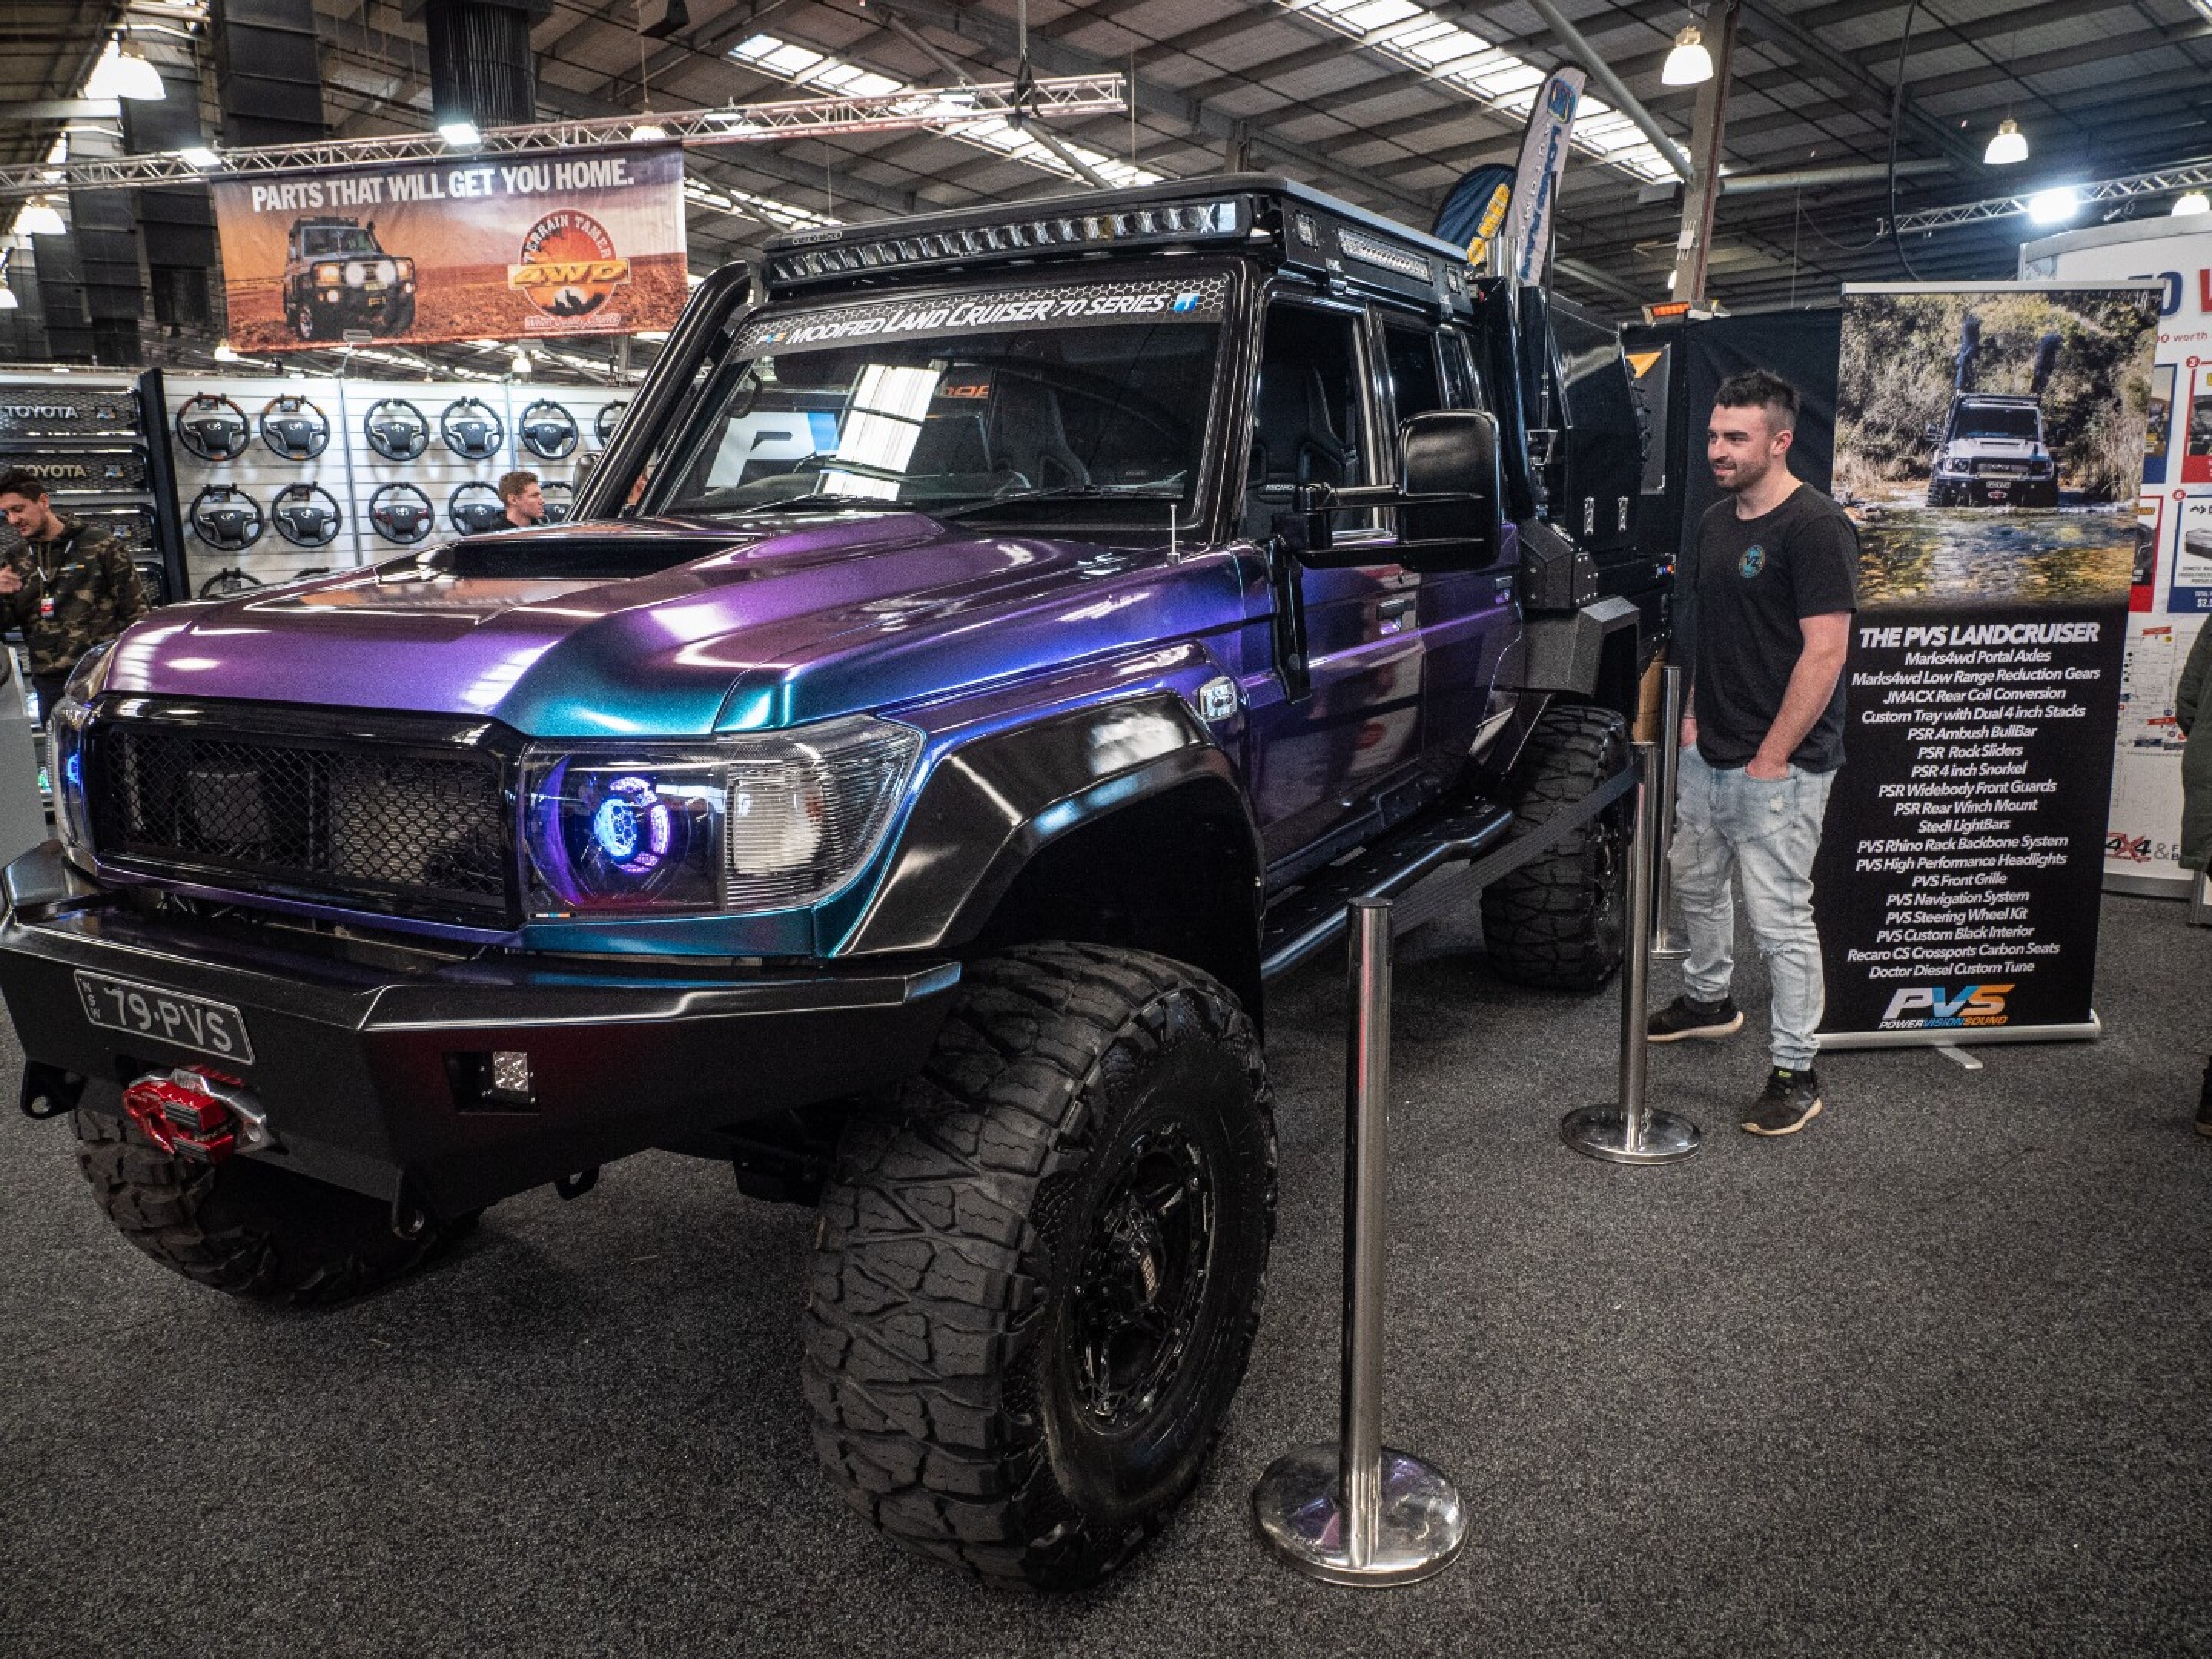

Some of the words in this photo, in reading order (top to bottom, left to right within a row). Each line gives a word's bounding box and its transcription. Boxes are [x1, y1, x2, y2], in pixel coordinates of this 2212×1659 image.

[253, 184, 323, 212] PARTS
[326, 178, 385, 206] THAT
[387, 174, 446, 203] WILL
[449, 167, 495, 197] GET
[501, 163, 551, 194] YOU
[555, 157, 635, 188] HOME.
[524, 215, 569, 263] TERRAIN
[575, 216, 613, 259] TAMER
[514, 264, 629, 286] 4WD
[786, 316, 885, 344] MODIFIED
[882, 309, 950, 333] LAND
[945, 299, 1056, 326] CRUISER
[1050, 299, 1088, 317] 70
[1084, 294, 1171, 315] SERIES
[2174, 331, 2208, 342] worth
[4, 405, 80, 419] TOYOTA
[12, 465, 87, 478] OYOTA
[1860, 628, 1902, 649] THE
[1903, 625, 1948, 647] PVS
[1949, 622, 2100, 646] LANDCRUISER
[1904, 649, 1975, 666] Marks4wd
[1976, 647, 2014, 664] Portal
[2013, 647, 2051, 663] Axles
[1851, 671, 1922, 686] Marks4wd
[1923, 671, 1952, 684] Low
[1953, 669, 1995, 686] Range
[1996, 667, 2063, 681] Reduction
[2064, 666, 2100, 680] Gears
[1883, 689, 1936, 704] JMACX
[1936, 689, 1966, 703] Rear
[1967, 687, 1992, 701] Coil
[1993, 686, 2066, 701] Conversion
[1861, 710, 1912, 724] Custom
[1913, 709, 1942, 726] Tray
[1942, 707, 1972, 721] with
[1973, 706, 2003, 720] Dual
[2004, 706, 2014, 720] 4
[2015, 705, 2043, 718] inch
[2044, 703, 2086, 718] Stacks
[1907, 727, 1935, 741] PSR
[1934, 726, 1989, 741] Ambush
[1990, 724, 2037, 738] BullBar
[1916, 746, 1945, 760] PSR
[1948, 744, 1980, 758] Rock
[1981, 743, 2023, 758] Sliders
[1910, 764, 1939, 778] PSR
[1939, 764, 1949, 778] 4
[1950, 763, 1977, 777] inch
[1978, 761, 2028, 777] Snorkel
[1878, 784, 1905, 798] PSR
[1907, 781, 1974, 798] Widebody
[1975, 781, 2009, 795] Front
[2010, 778, 2057, 793] Guards
[1893, 803, 1920, 816] PSR
[1921, 801, 1952, 815] Rear
[1955, 800, 1992, 813] Winch
[1995, 799, 2038, 812] Mount
[1953, 818, 2011, 835] LightBars
[1856, 839, 1886, 853] PVS
[1884, 838, 1923, 853] Rhino
[1924, 836, 1957, 852] Rack
[1957, 836, 2019, 850] Backbone
[2021, 835, 2068, 850] System
[2154, 843, 2169, 860] &
[1855, 858, 1883, 872] PVS
[1883, 856, 1914, 873] High
[1916, 855, 1995, 870] Performance
[1998, 852, 2068, 869] Headlights
[1912, 875, 1940, 887] PVS
[1939, 873, 1974, 887] Front
[1975, 870, 2006, 886] Grille
[1886, 893, 1912, 907] PVS
[1913, 892, 1982, 909] Navigation
[1982, 890, 2029, 906] System
[1886, 912, 1913, 926] PVS
[1912, 910, 1966, 926] Steering
[1969, 907, 2010, 921] Wheel
[2009, 907, 2028, 919] Kit
[1876, 929, 1903, 942] PVS
[1904, 929, 1952, 942] Custom
[1955, 926, 1988, 939] Black
[1988, 924, 2035, 938] Interior
[1847, 949, 1891, 962] Recaro
[1892, 947, 1911, 959] CS
[1912, 945, 1977, 961] Crossports
[1978, 943, 2025, 956] Carbon
[2025, 942, 2060, 955] Seats
[1869, 965, 1912, 979] Doctor
[1913, 962, 1954, 976] Diesel
[1955, 962, 2002, 975] Custom
[2004, 961, 2034, 973] Tune
[1882, 983, 2015, 1021] PVS
